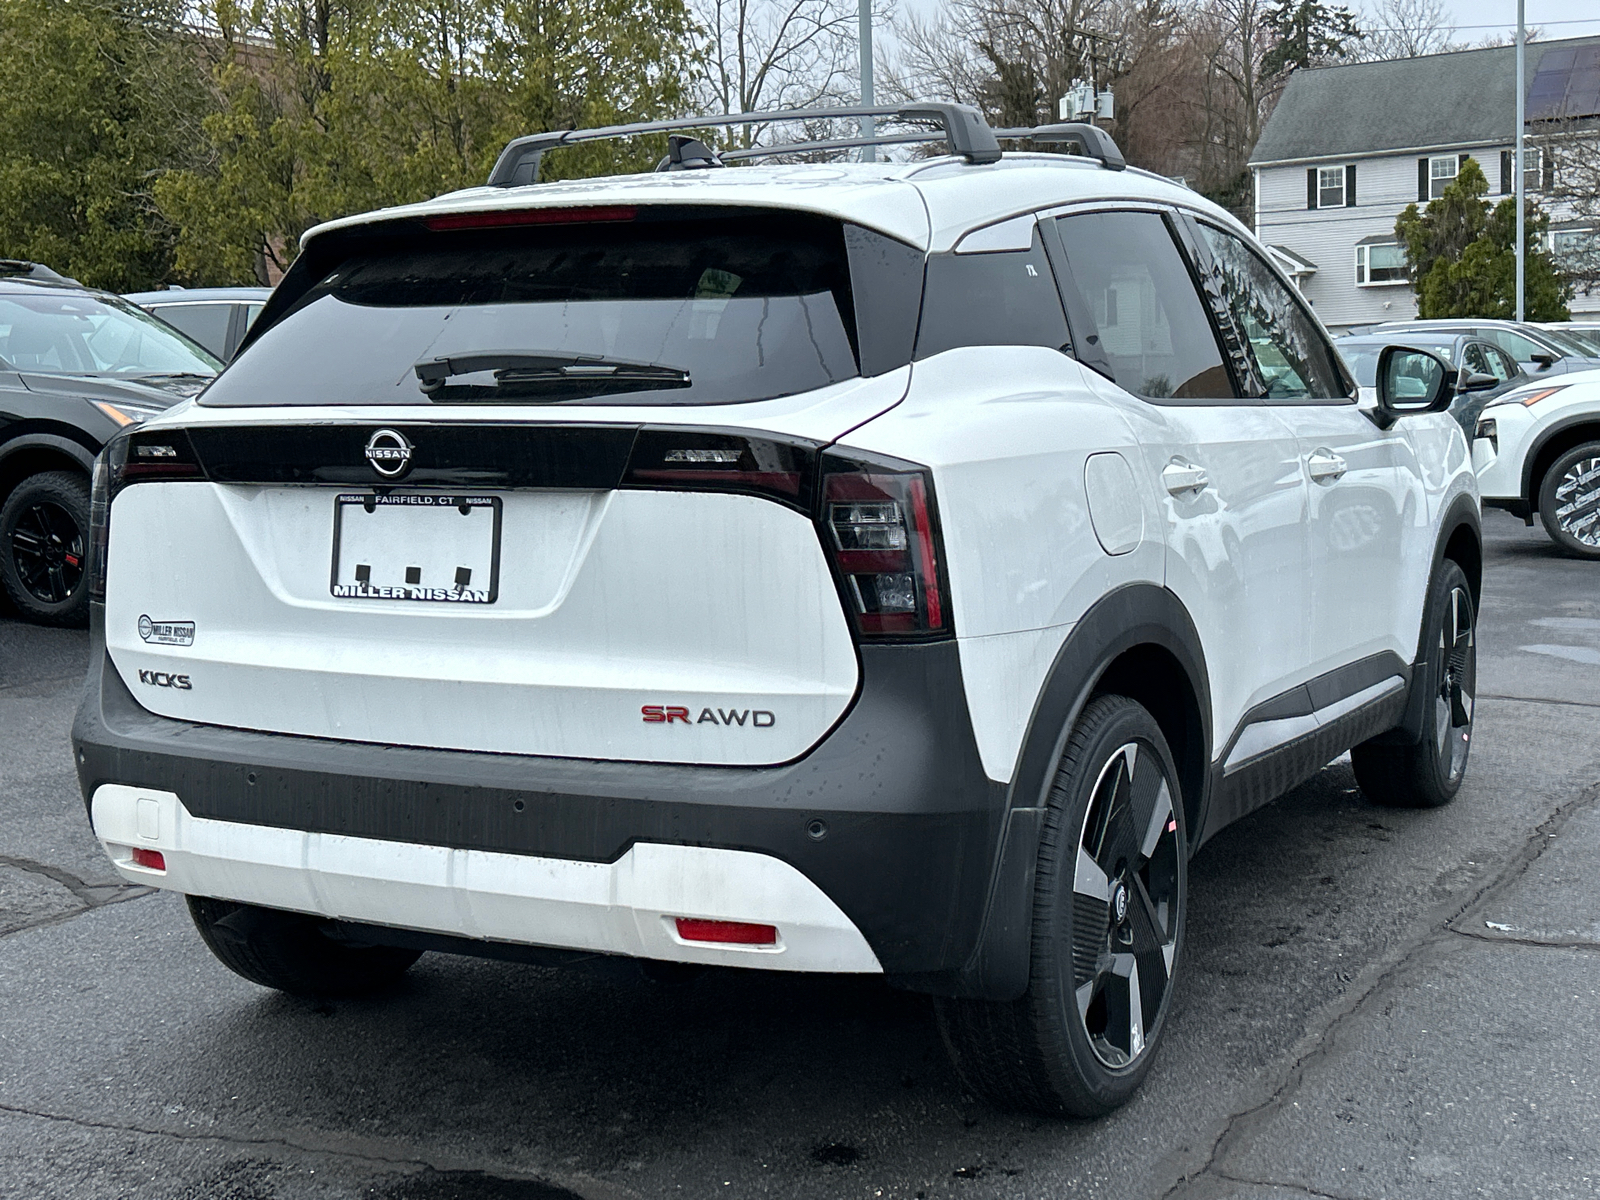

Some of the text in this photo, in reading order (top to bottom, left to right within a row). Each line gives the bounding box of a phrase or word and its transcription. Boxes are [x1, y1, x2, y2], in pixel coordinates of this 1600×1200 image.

[365, 450, 410, 458] NISSAN
[375, 496, 435, 505] FAIRFIELD,
[439, 497, 455, 505] CT
[333, 585, 489, 602] MILLER NISSAN
[139, 669, 192, 690] KICKS
[641, 705, 776, 727] SR AWD
